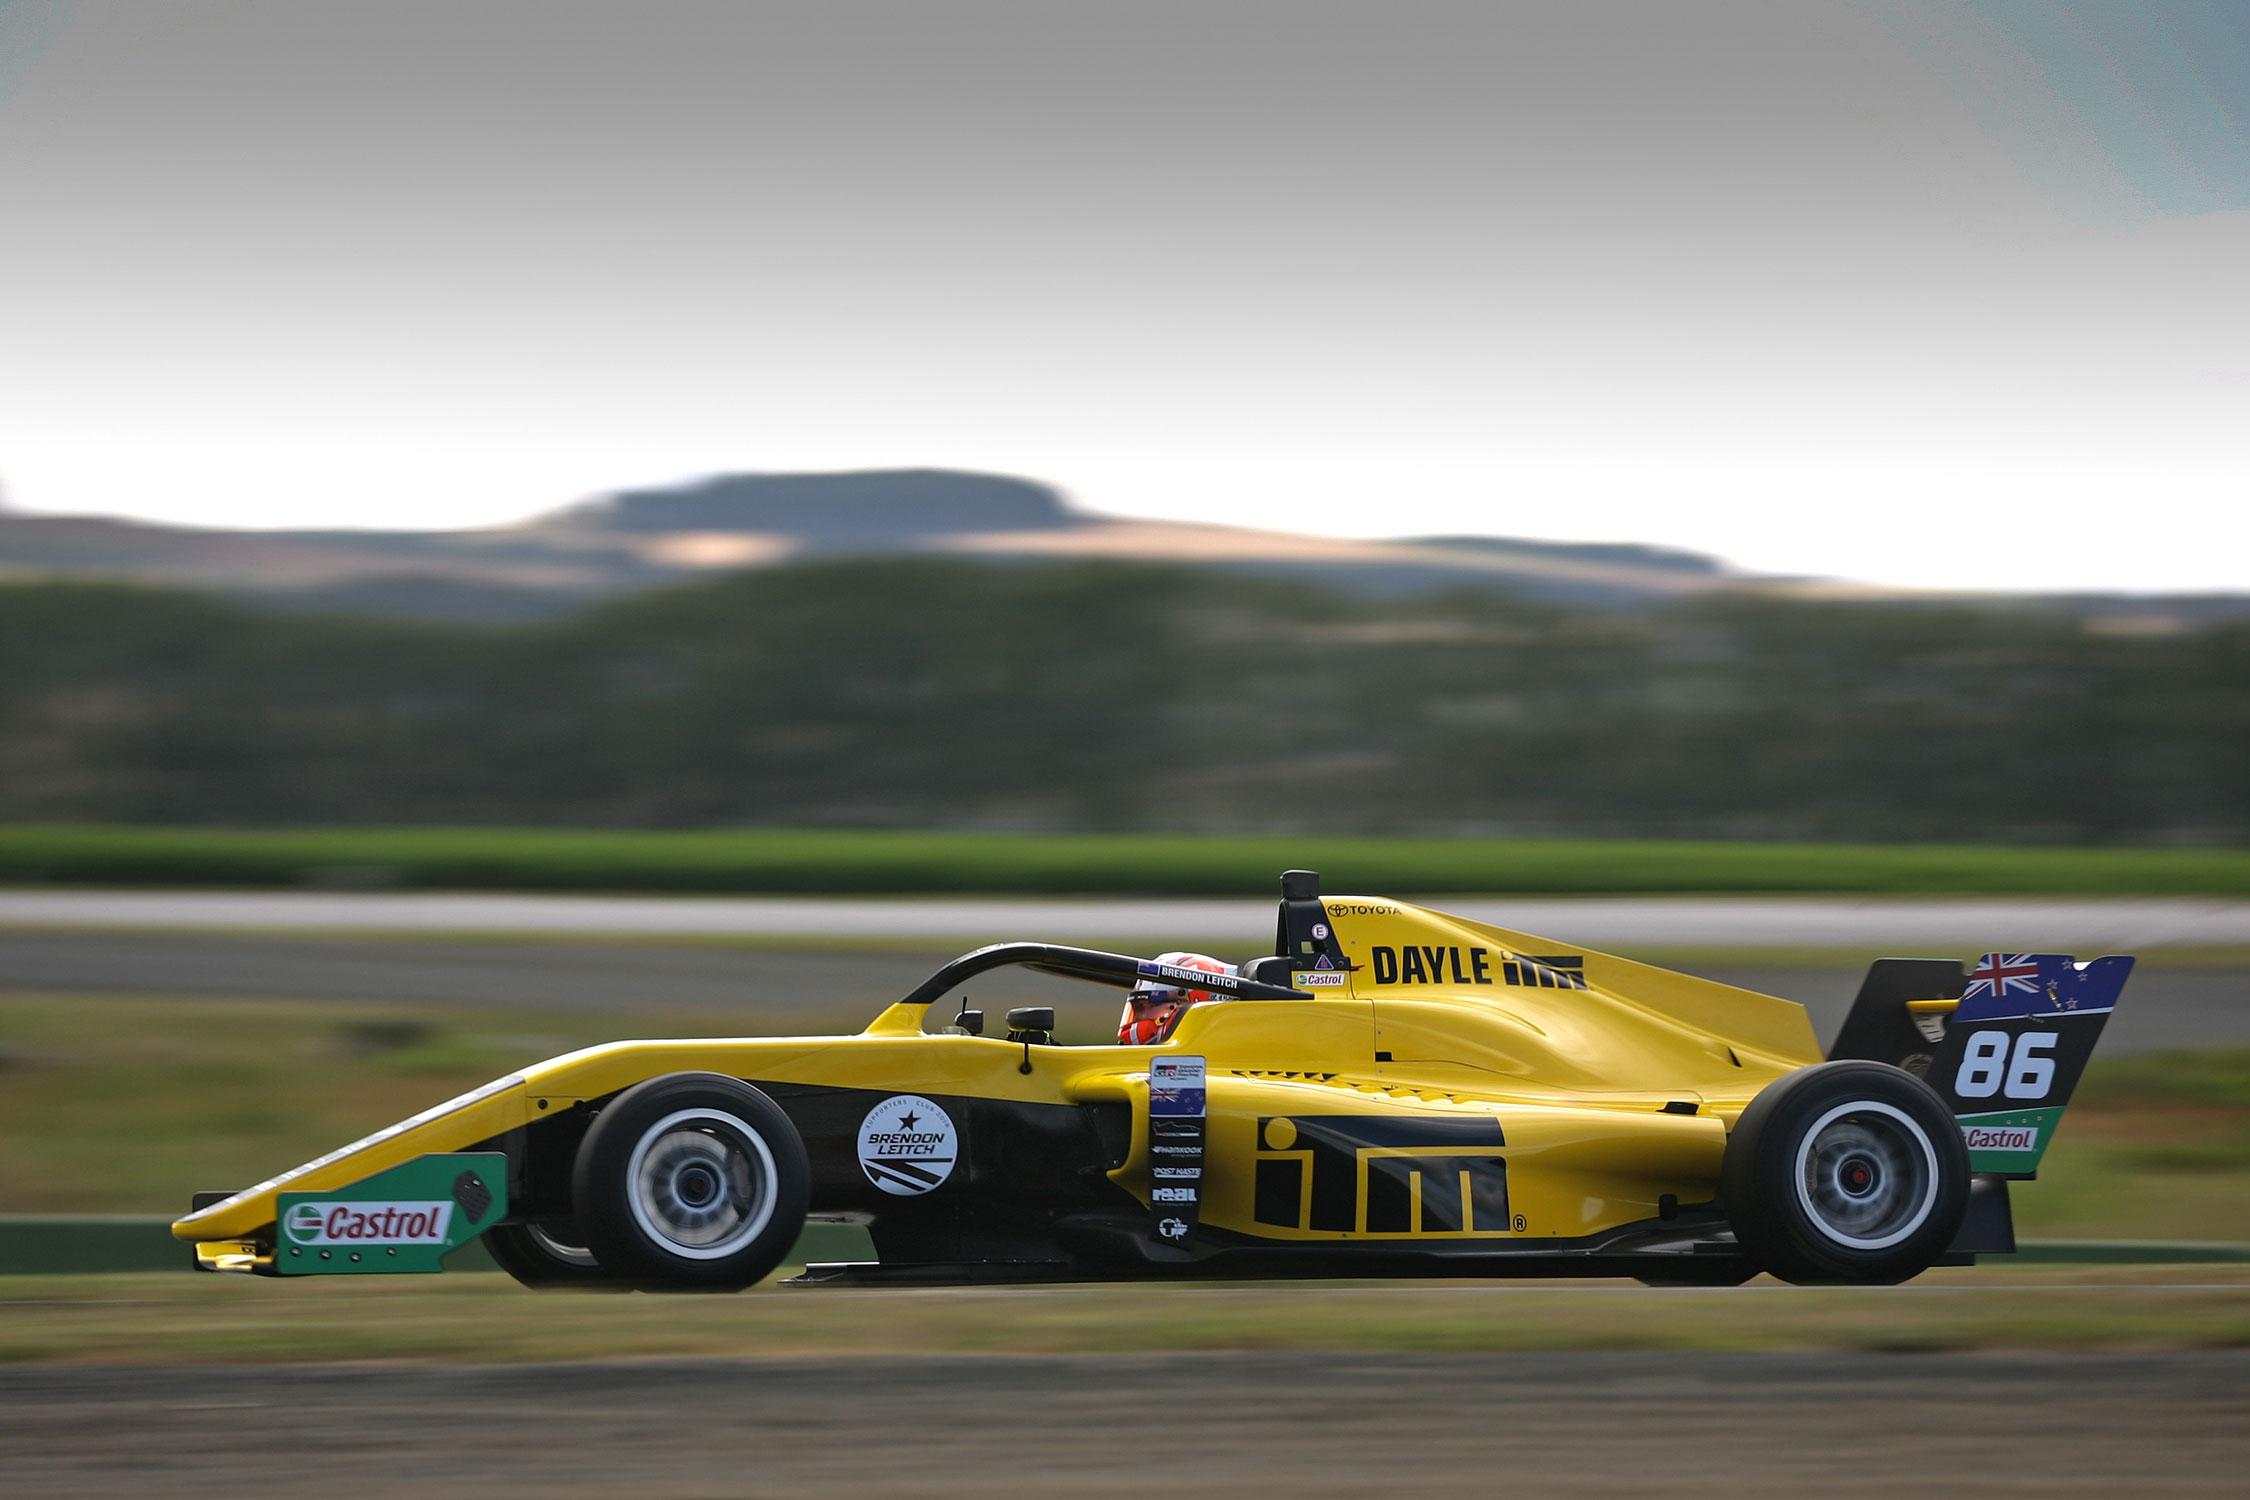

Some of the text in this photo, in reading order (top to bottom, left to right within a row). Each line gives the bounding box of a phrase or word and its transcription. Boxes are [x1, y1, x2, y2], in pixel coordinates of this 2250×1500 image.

[1351, 906, 1402, 915] TOYOTA
[1316, 927, 1324, 936] E
[1371, 946, 1492, 985] DAYLE
[1161, 967, 1238, 989] BRENDON LEITCH
[1308, 973, 1342, 985] Castrol
[1954, 1030, 2059, 1100] 86
[868, 1133, 945, 1144] BRENDON
[1967, 1129, 2031, 1148] Castrol
[877, 1145, 936, 1155] LEITCH
[1152, 1187, 1197, 1202] real
[326, 1206, 440, 1239] Castrol
